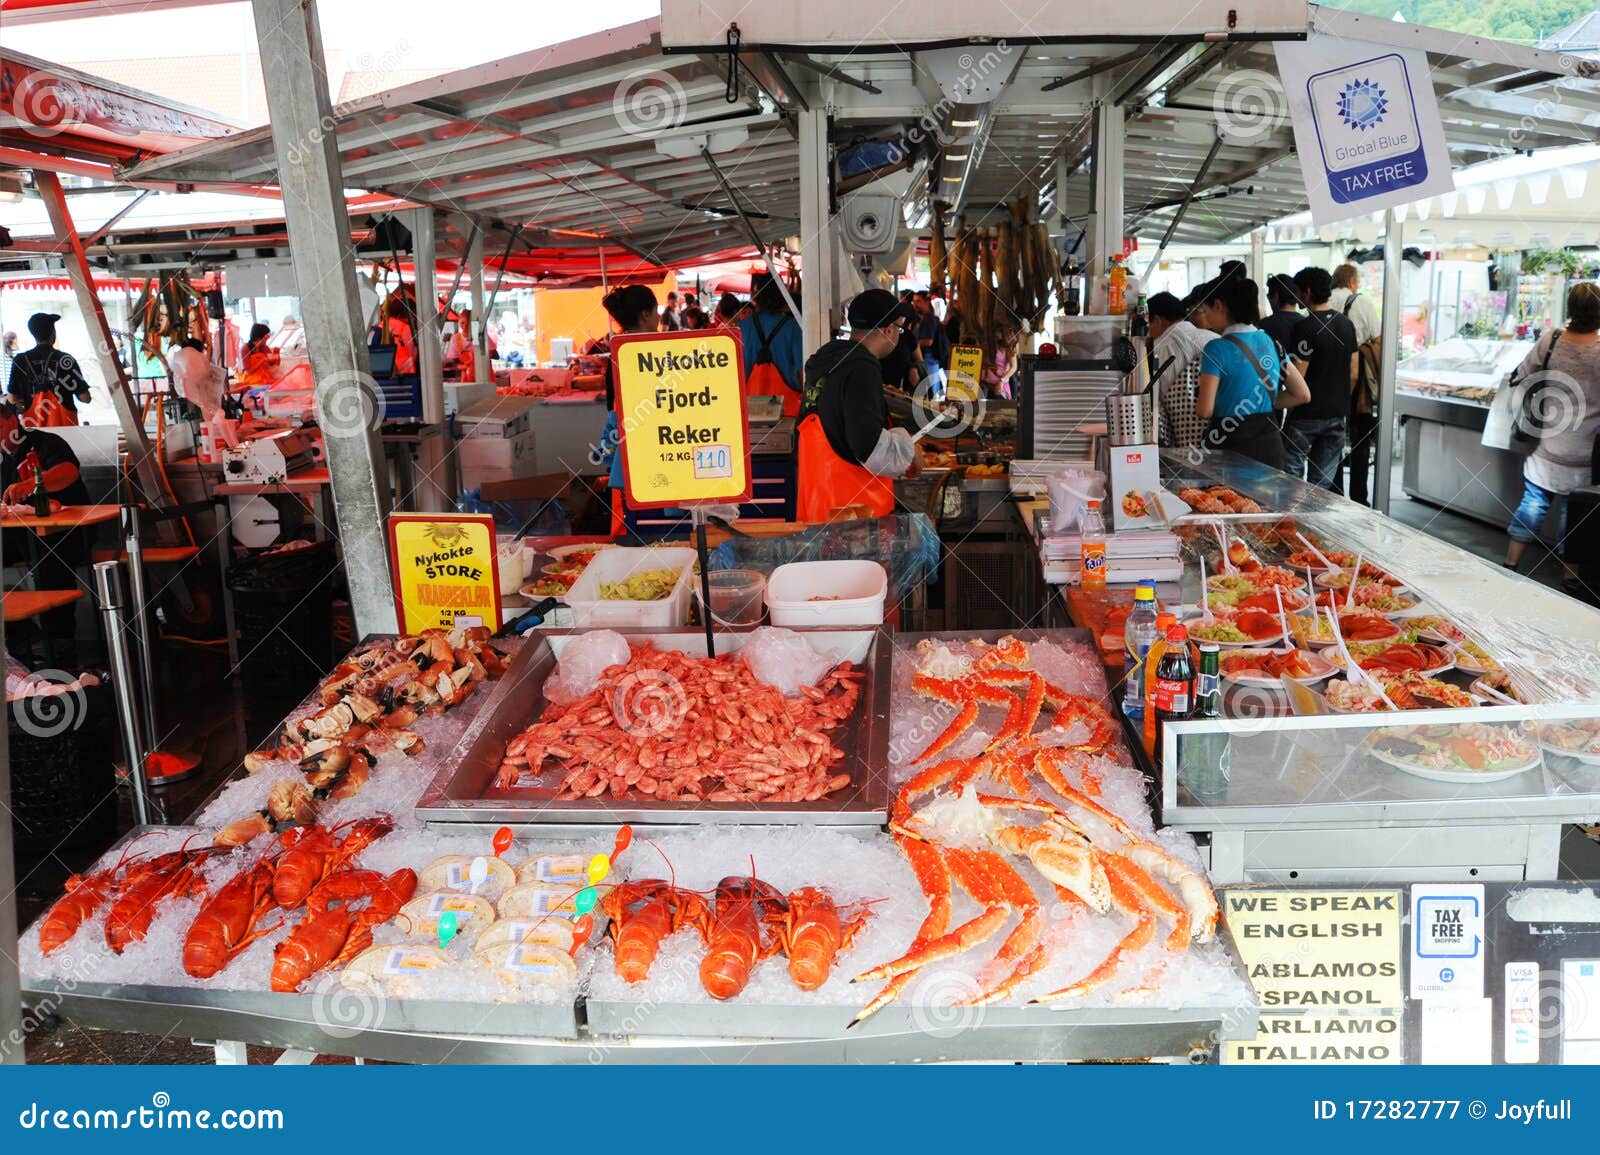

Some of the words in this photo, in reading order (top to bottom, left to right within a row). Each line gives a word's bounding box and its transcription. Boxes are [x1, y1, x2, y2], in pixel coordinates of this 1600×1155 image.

[1335, 139, 1377, 161] Global
[1378, 134, 1408, 149] Blue
[1342, 171, 1374, 192] TAX
[1375, 160, 1415, 184] FREE
[637, 349, 729, 377] Nykokte
[655, 386, 718, 413] Fjord-
[657, 425, 721, 445] Reker
[660, 452, 674, 462] 1/2
[697, 449, 726, 469] 110
[415, 546, 473, 567] Nykokte
[425, 565, 482, 581] STORE
[1230, 897, 1278, 912] WE
[1290, 896, 1395, 911] SPEAK
[1434, 909, 1461, 923] TAX
[1243, 923, 1383, 938] ENGLISH
[1431, 924, 1464, 937] FREE
[1245, 962, 1396, 978] ABLAMOS
[1258, 990, 1382, 1005] SPANOL
[1257, 1020, 1397, 1034] ARLIAMO
[1237, 1046, 1390, 1060] ITALIANO
